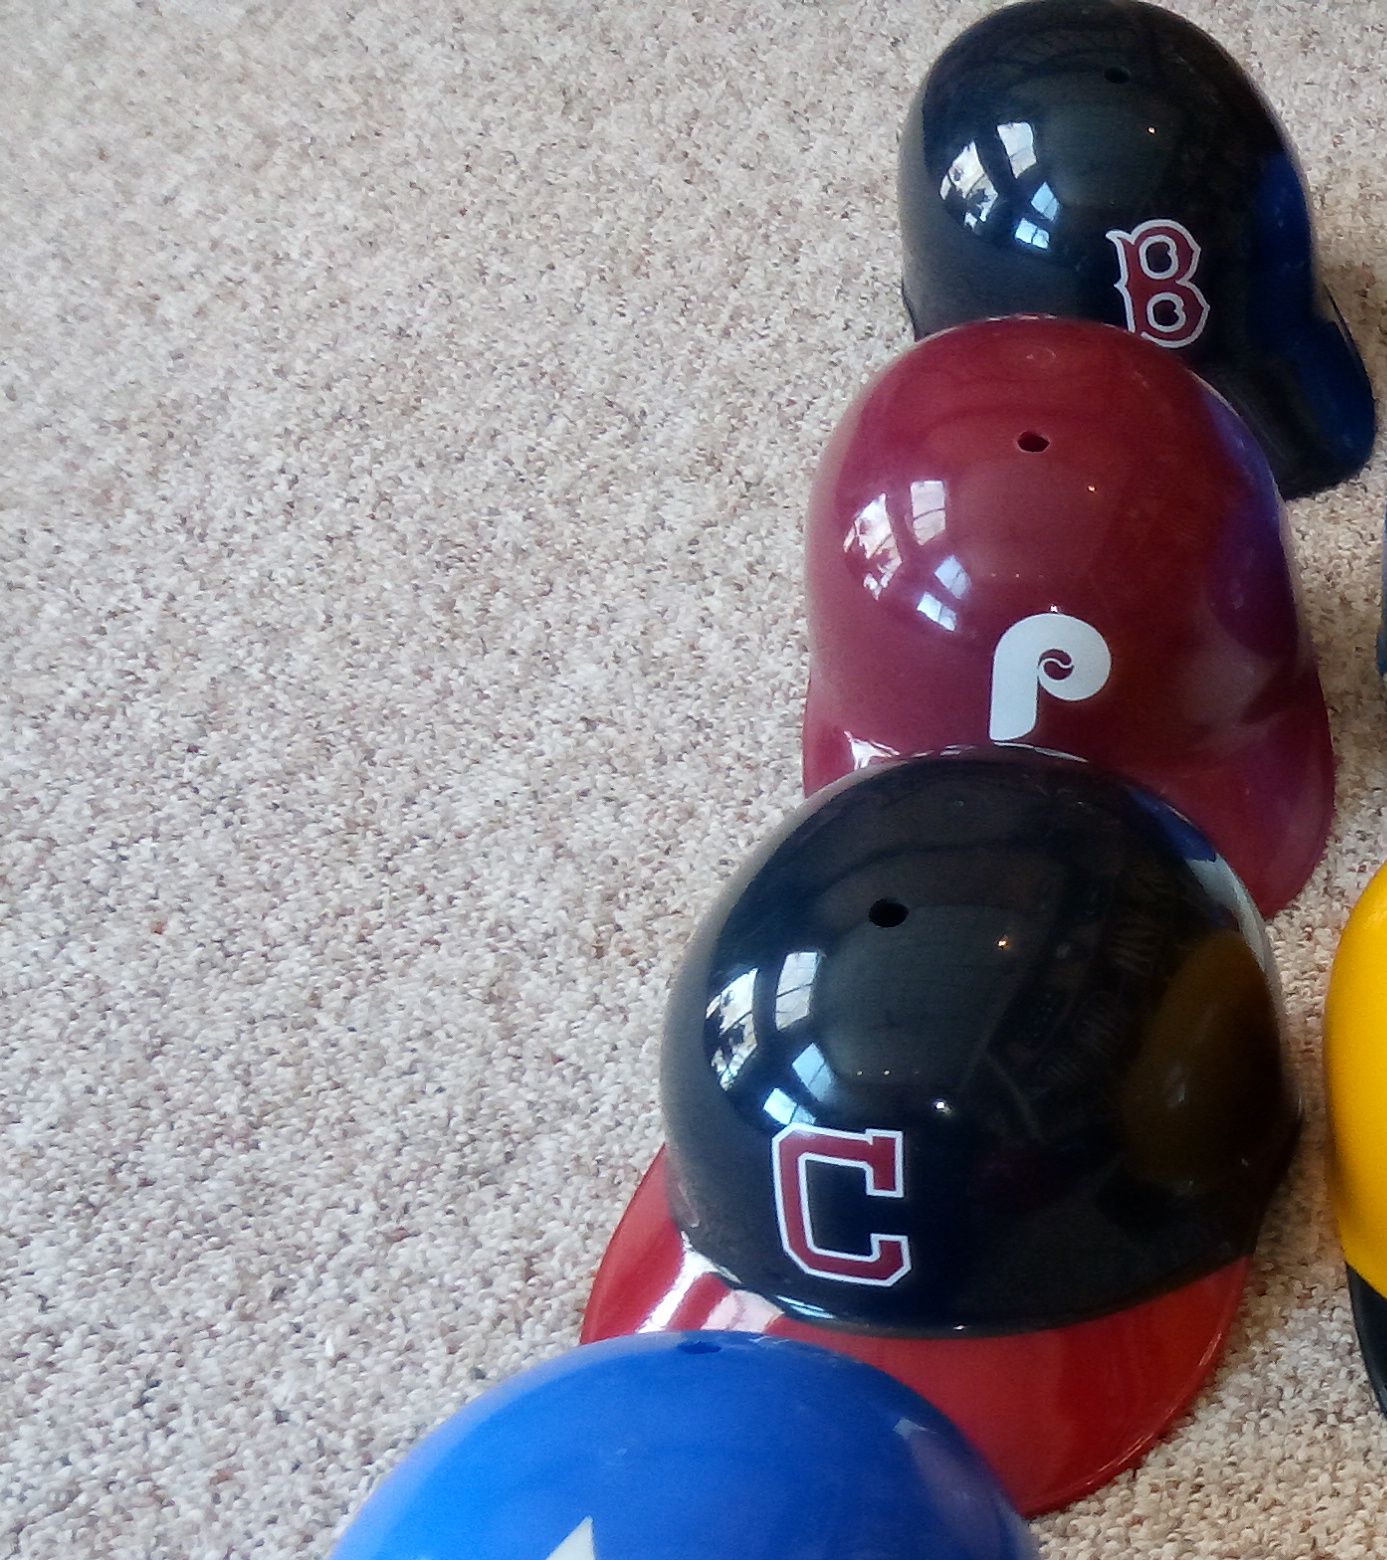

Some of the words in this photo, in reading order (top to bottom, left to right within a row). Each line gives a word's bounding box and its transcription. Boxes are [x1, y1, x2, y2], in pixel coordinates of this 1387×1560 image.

[1106, 219, 1209, 348] B
[990, 613, 1111, 741] P
[773, 1123, 912, 1286] C
